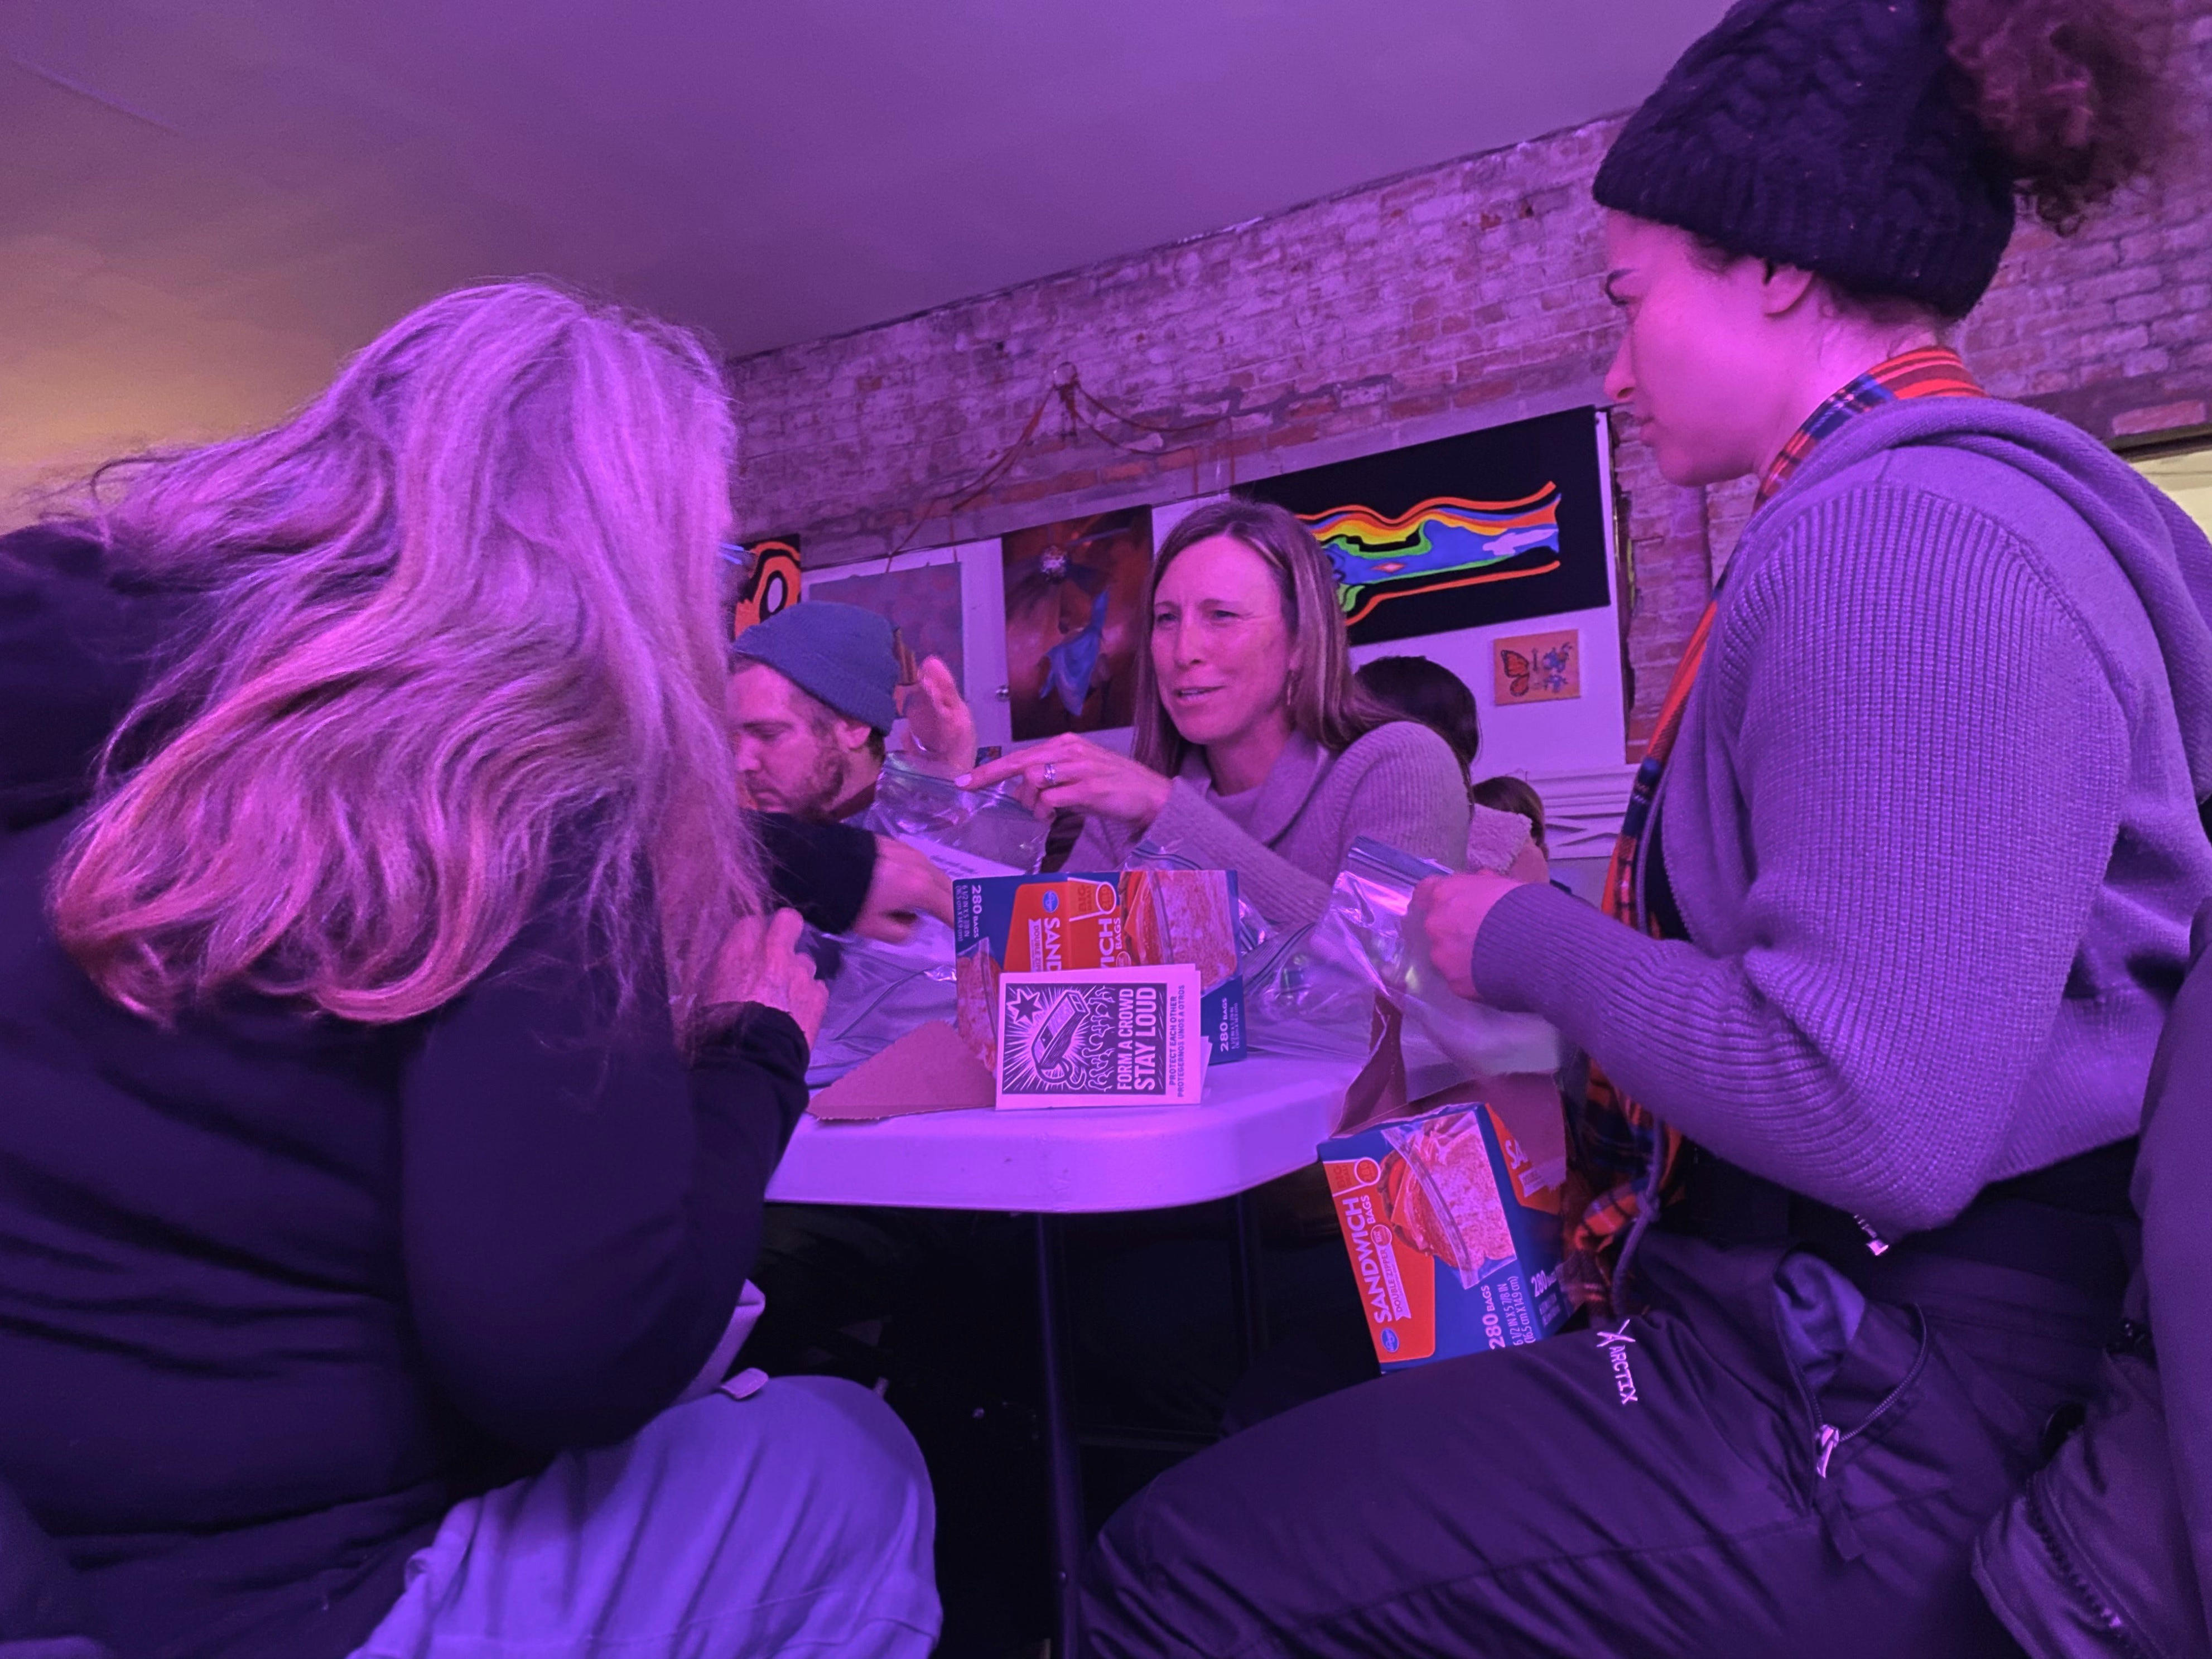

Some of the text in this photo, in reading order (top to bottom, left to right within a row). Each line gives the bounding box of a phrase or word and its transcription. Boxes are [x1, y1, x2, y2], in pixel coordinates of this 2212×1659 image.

[972, 885, 982, 914] 280
[1114, 918, 1122, 949] BAGS
[1117, 988, 1134, 1090] FORM A CROWD
[1134, 987, 1156, 1091] STAY LOUD
[1220, 1022, 1229, 1052] 280
[1169, 1048, 1177, 1086] PROTECT
[1361, 1195, 1376, 1224] BAGS
[1342, 1197, 1392, 1324] SANDWICH
[1380, 1248, 1393, 1277] ZIPPER
[1388, 1279, 1403, 1312] DOUBLE
[1497, 1283, 1509, 1292] IN
[1507, 1276, 1520, 1291] cm)
[1531, 1270, 1548, 1298] 280
[1500, 1292, 1512, 1305] 7/8
[1481, 1285, 1506, 1349] 280 BAGS
[1507, 1317, 1518, 1327] IN
[1520, 1313, 1530, 1325] cm
[1510, 1327, 1522, 1339] 1/2
[1609, 1345, 1638, 1405] ARCTIX
